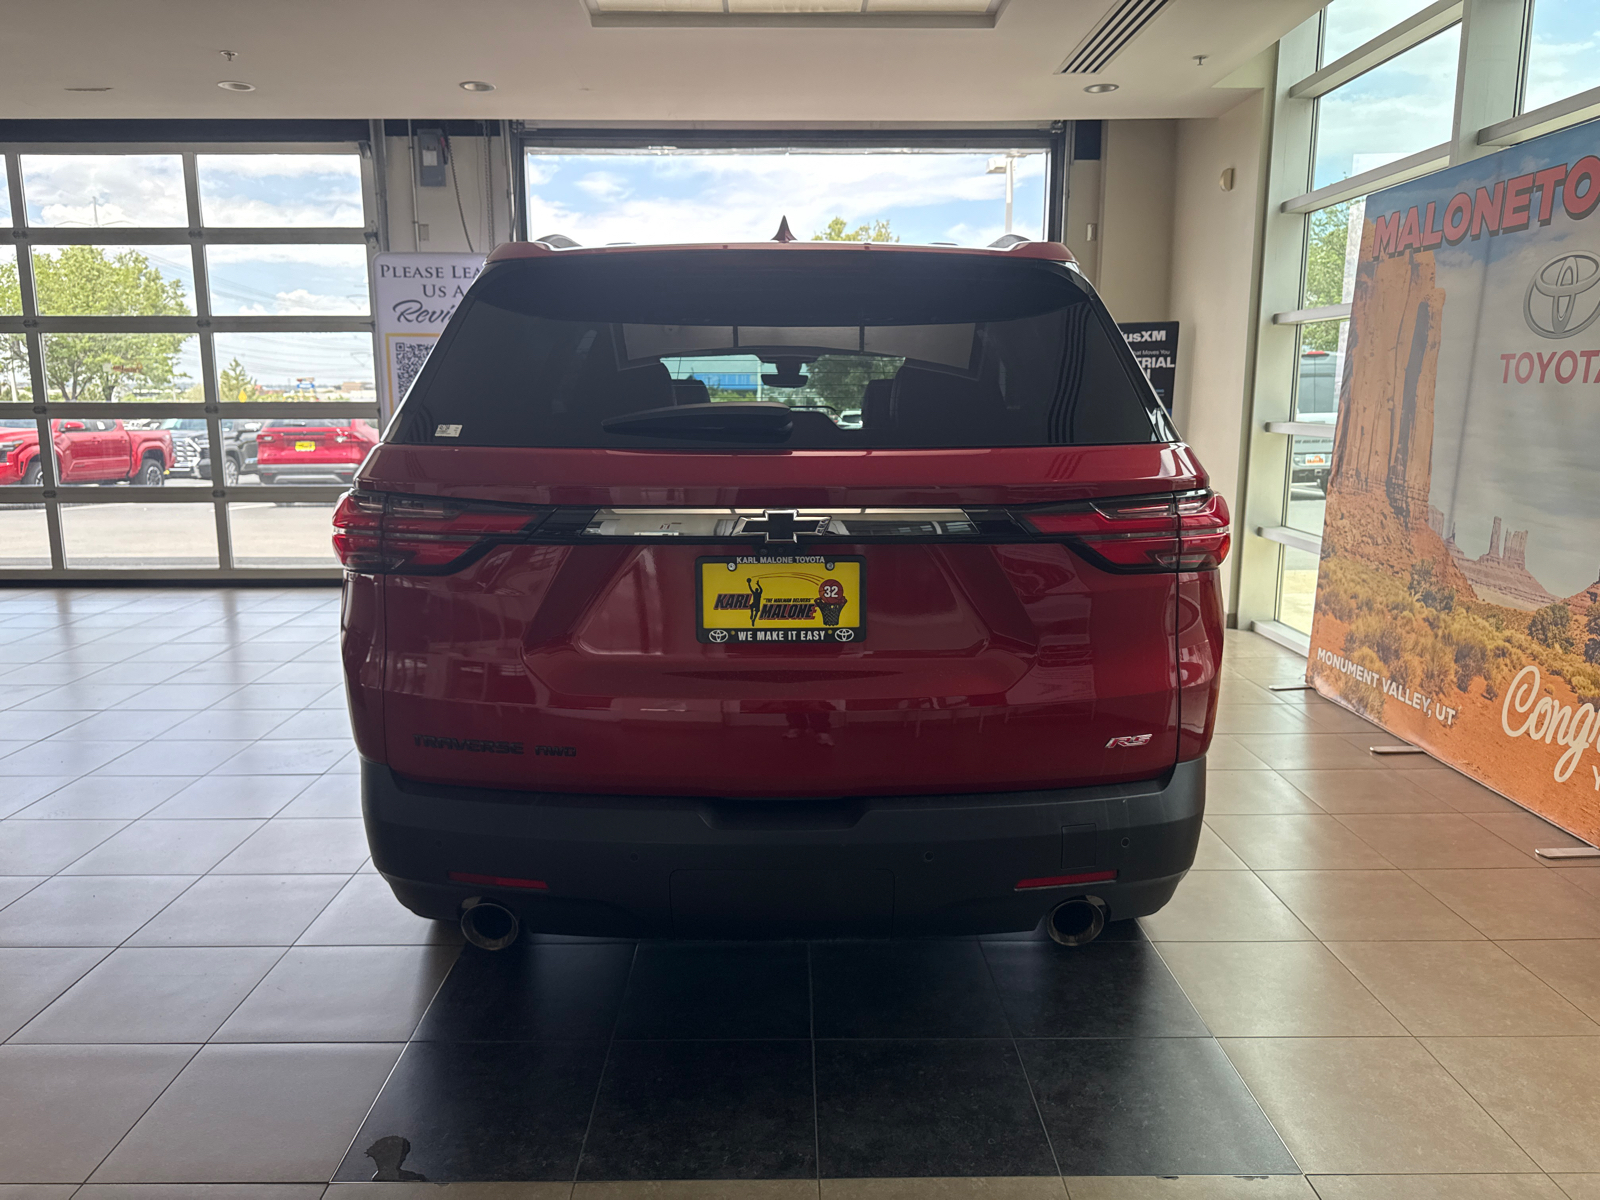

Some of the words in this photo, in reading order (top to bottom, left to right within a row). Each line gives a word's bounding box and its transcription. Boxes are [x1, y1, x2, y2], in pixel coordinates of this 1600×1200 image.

[380, 264, 445, 279] PLEASE
[453, 285, 466, 298] A
[392, 299, 455, 323] Revi
[1121, 330, 1166, 342] usXM
[824, 585, 838, 598] 32
[713, 594, 752, 610] KARL
[759, 604, 817, 620] MALONE
[738, 631, 753, 641] WE
[757, 631, 784, 640] MAKE
[788, 631, 797, 640] IT
[801, 630, 826, 640] EASY
[1317, 647, 1380, 688] MONUMENT
[1382, 676, 1433, 718] VALLEY,
[1435, 704, 1456, 725] UT
[412, 734, 524, 755] TRAVERSE
[535, 745, 577, 757] AWD
[1105, 733, 1153, 749] RS
